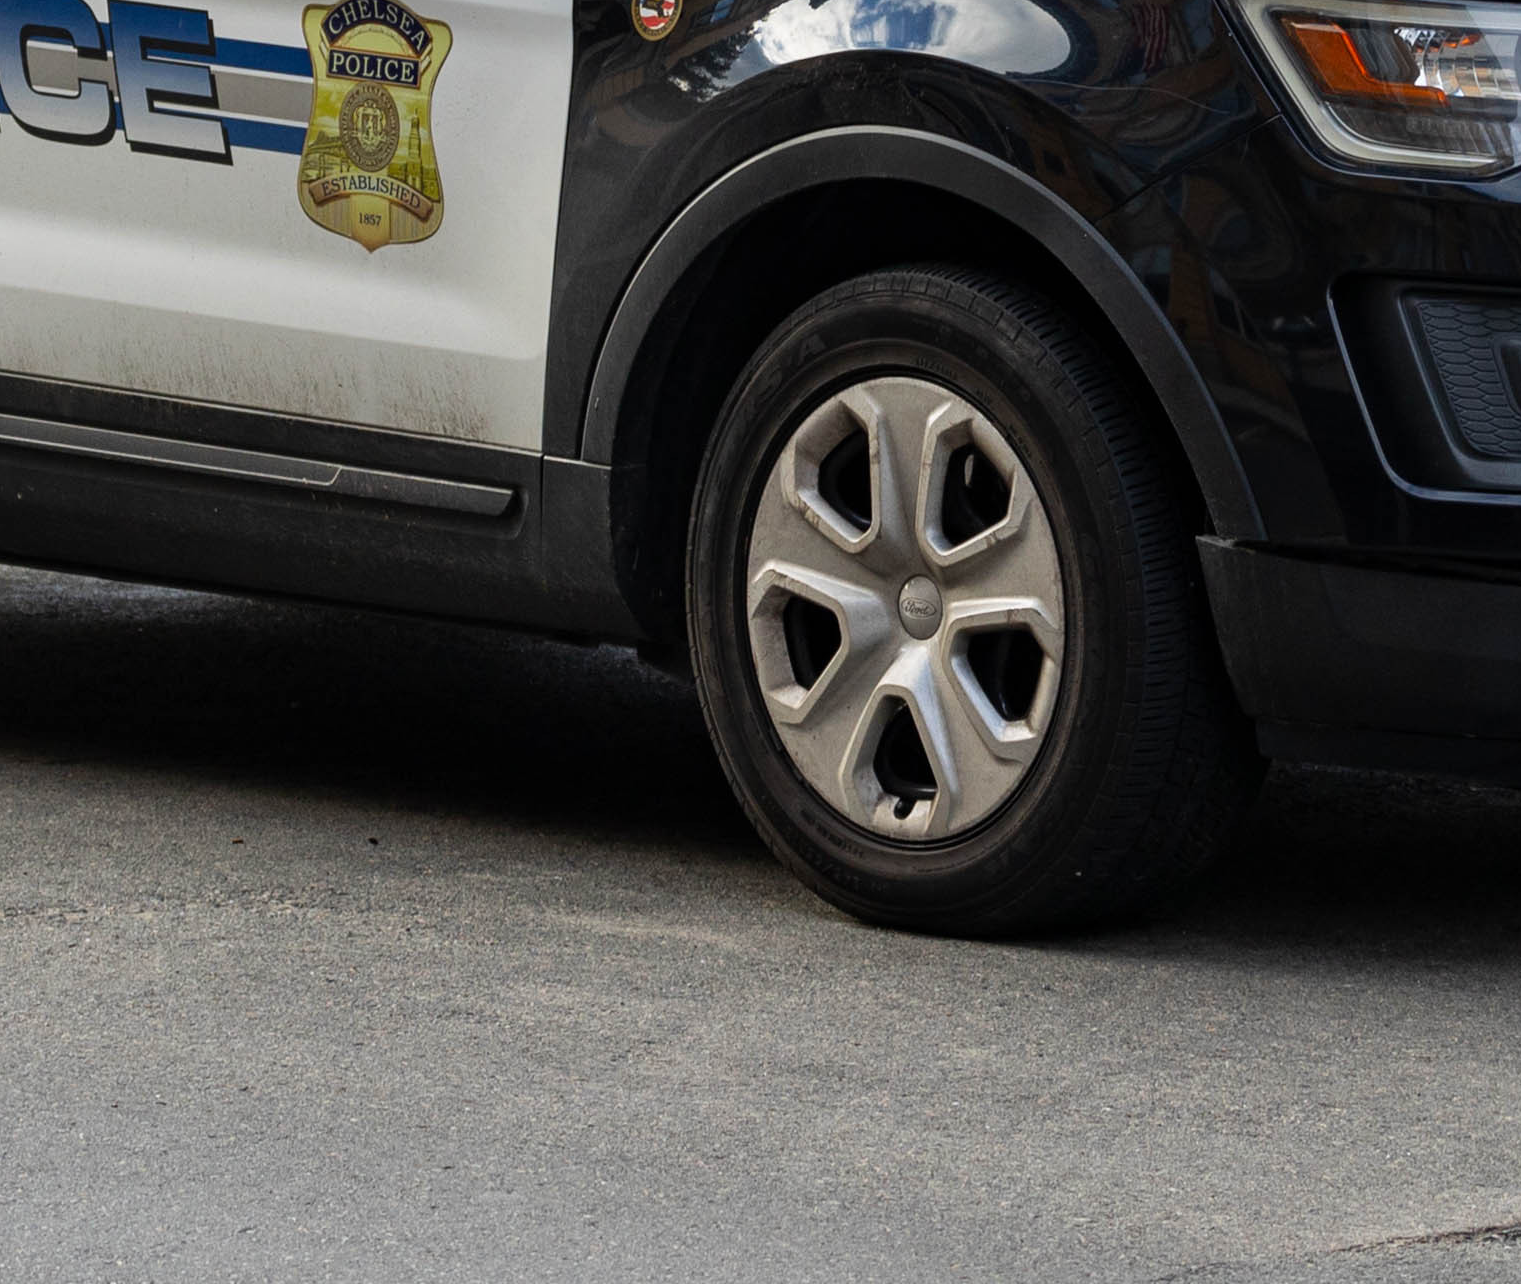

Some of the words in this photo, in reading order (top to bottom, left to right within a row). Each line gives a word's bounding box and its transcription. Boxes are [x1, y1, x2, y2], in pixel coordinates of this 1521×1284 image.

[331, 51, 416, 83] POLICE
[322, 174, 422, 210] ESTABLISHED
[358, 211, 382, 227] 1857
